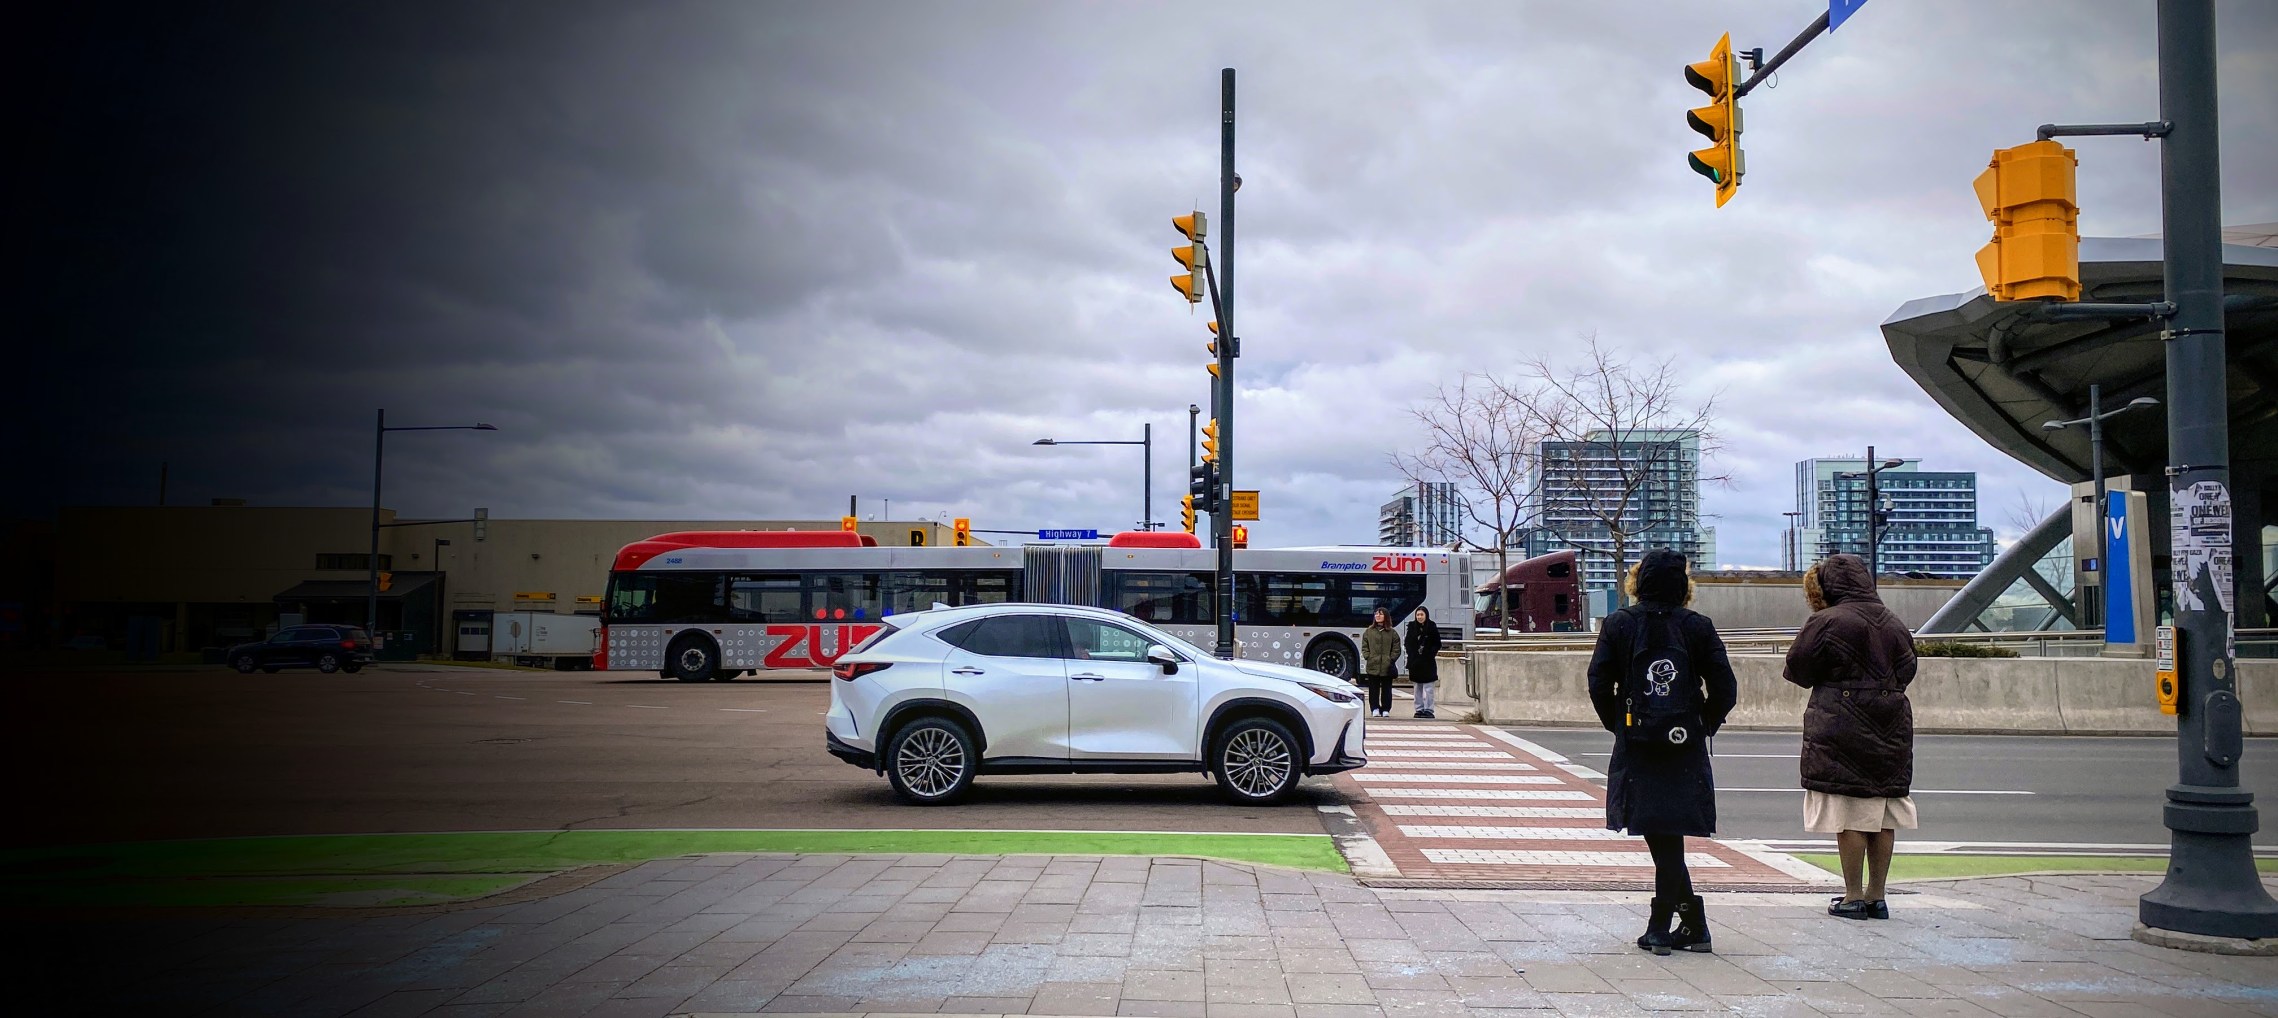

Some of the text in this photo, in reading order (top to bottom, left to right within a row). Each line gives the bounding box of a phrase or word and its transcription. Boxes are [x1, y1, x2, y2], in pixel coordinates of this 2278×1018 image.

[1045, 530, 1091, 539] Highway 7
[2110, 516, 2124, 539] V
[1321, 561, 1367, 571] Brampton
[763, 608, 882, 667] zü
